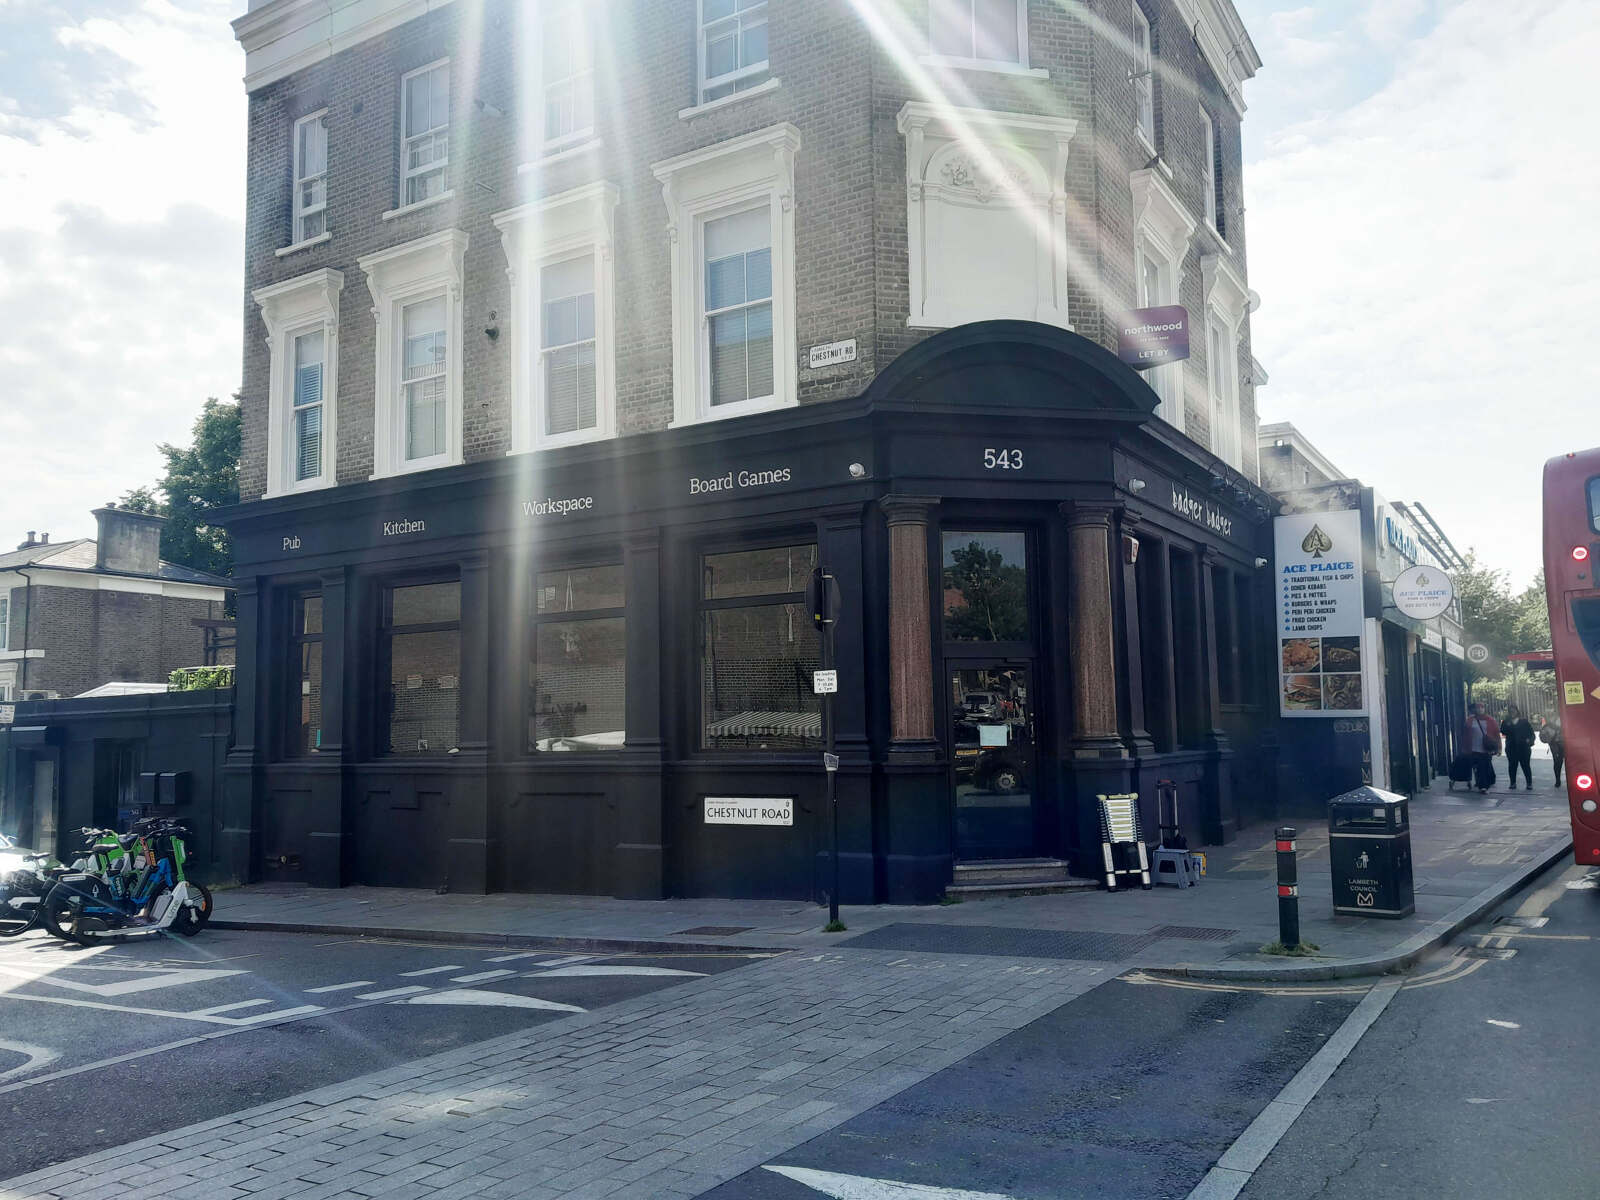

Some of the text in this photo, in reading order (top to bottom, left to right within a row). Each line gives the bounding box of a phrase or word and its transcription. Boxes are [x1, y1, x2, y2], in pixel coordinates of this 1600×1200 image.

[1124, 320, 1183, 335] northwood
[811, 348, 842, 362] CHESTNUT
[845, 346, 854, 354] RD
[1139, 350, 1154, 359] LET
[984, 448, 1023, 470] 543
[689, 468, 791, 495] Board Games
[522, 496, 593, 516] Workspace
[1171, 481, 1232, 537] badger badger
[383, 518, 425, 536] Kitchen
[282, 536, 302, 551] Pub
[1283, 561, 1355, 574] ACE PLAICE
[1290, 575, 1321, 583] TRADITIONAL
[707, 807, 790, 819] CHESTNUT ROAD
